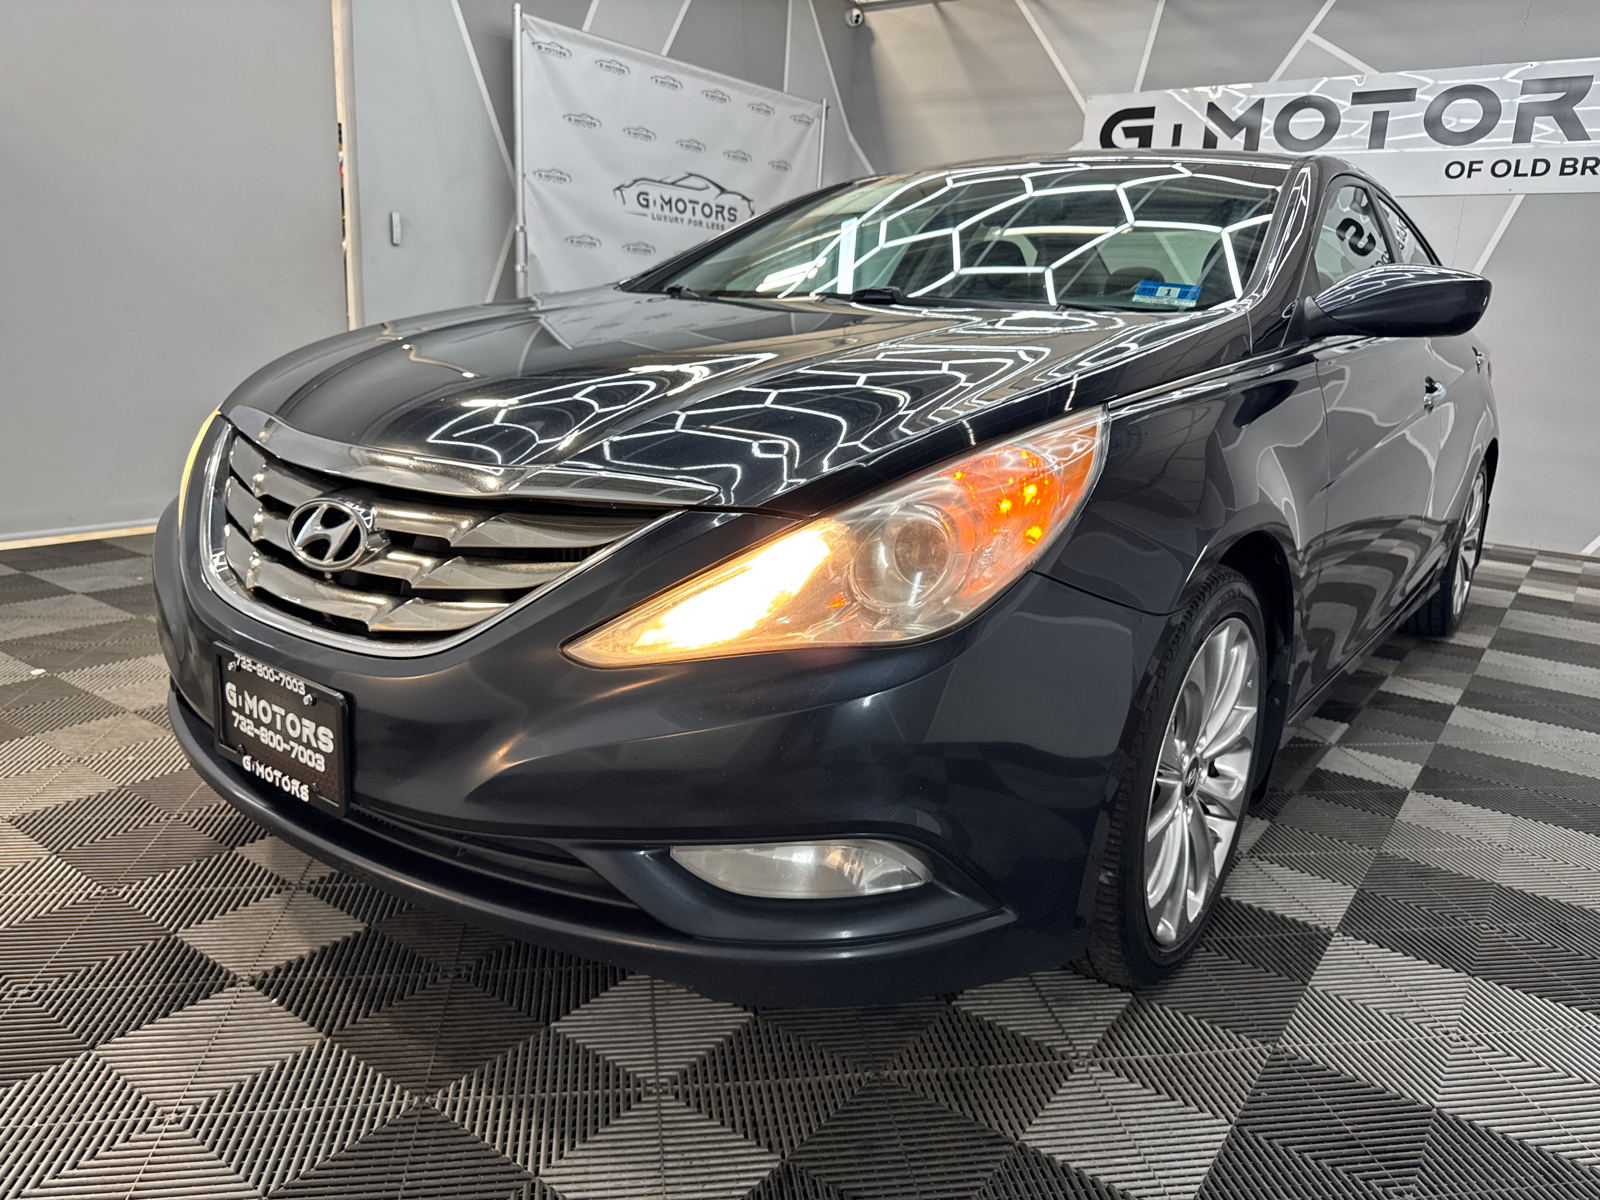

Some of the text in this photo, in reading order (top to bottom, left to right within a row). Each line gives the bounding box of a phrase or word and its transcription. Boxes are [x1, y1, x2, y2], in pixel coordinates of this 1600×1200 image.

[1444, 156, 1600, 180] OF OLD BR
[651, 213, 726, 232] LUXURY FOR LESS
[1164, 288, 1172, 297] 1
[234, 653, 306, 696] 732-800-7003
[231, 710, 326, 773] 732-800-7003
